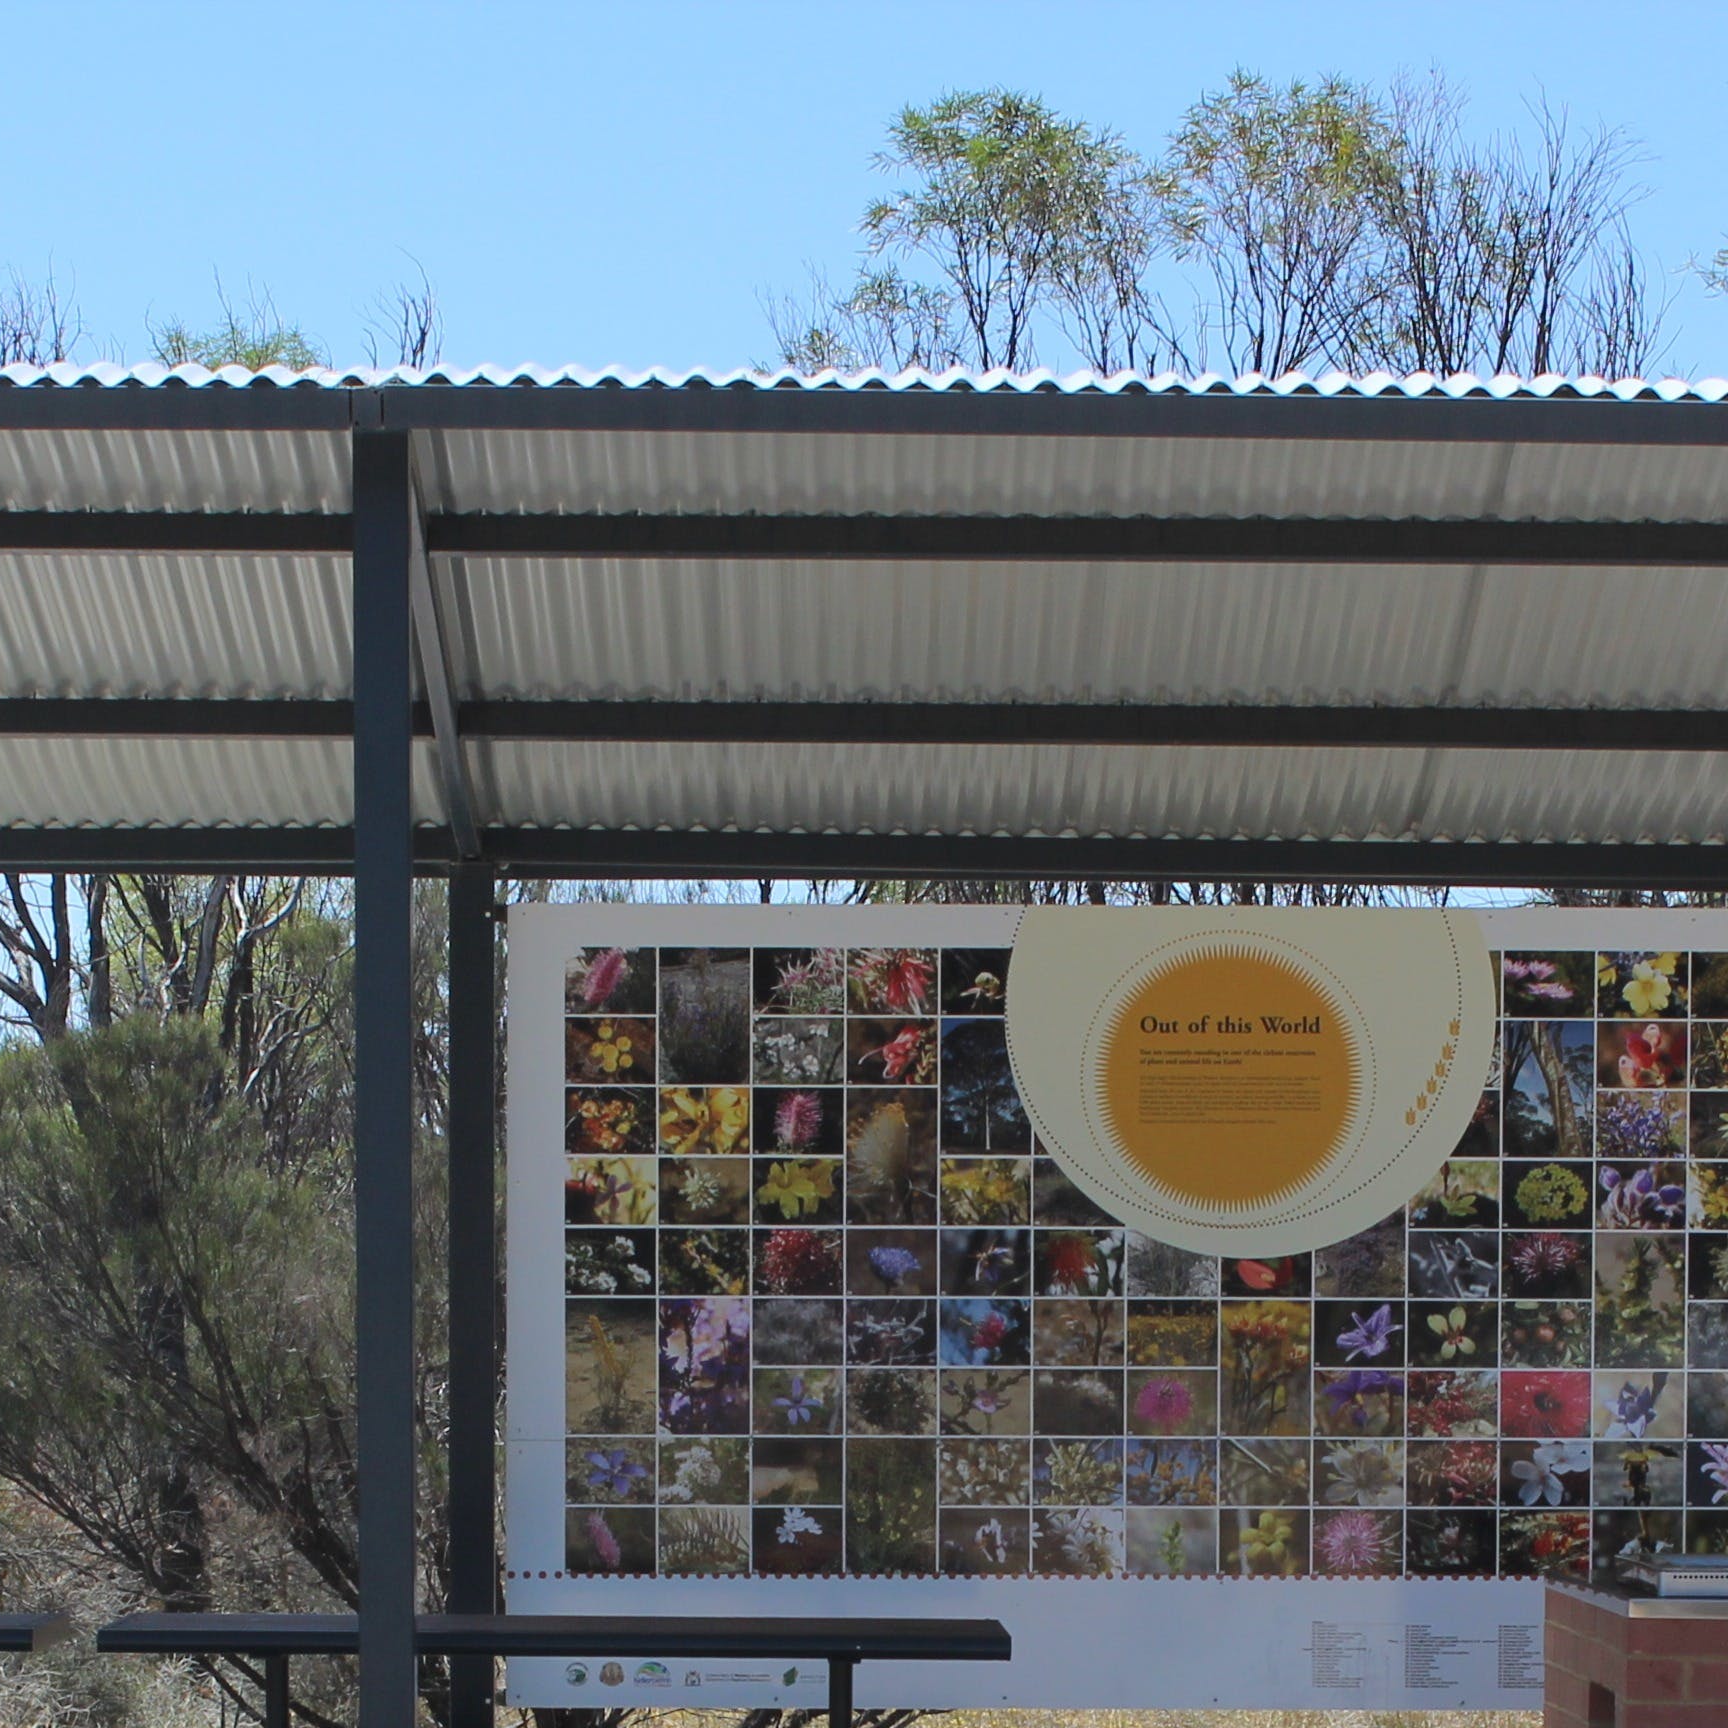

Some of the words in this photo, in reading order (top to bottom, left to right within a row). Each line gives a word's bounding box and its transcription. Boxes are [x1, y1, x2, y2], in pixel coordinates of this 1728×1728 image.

[1139, 1015, 1179, 1034] Out
[1187, 1015, 1210, 1034] of
[1217, 1015, 1253, 1034] this
[1259, 1015, 1321, 1034] World
